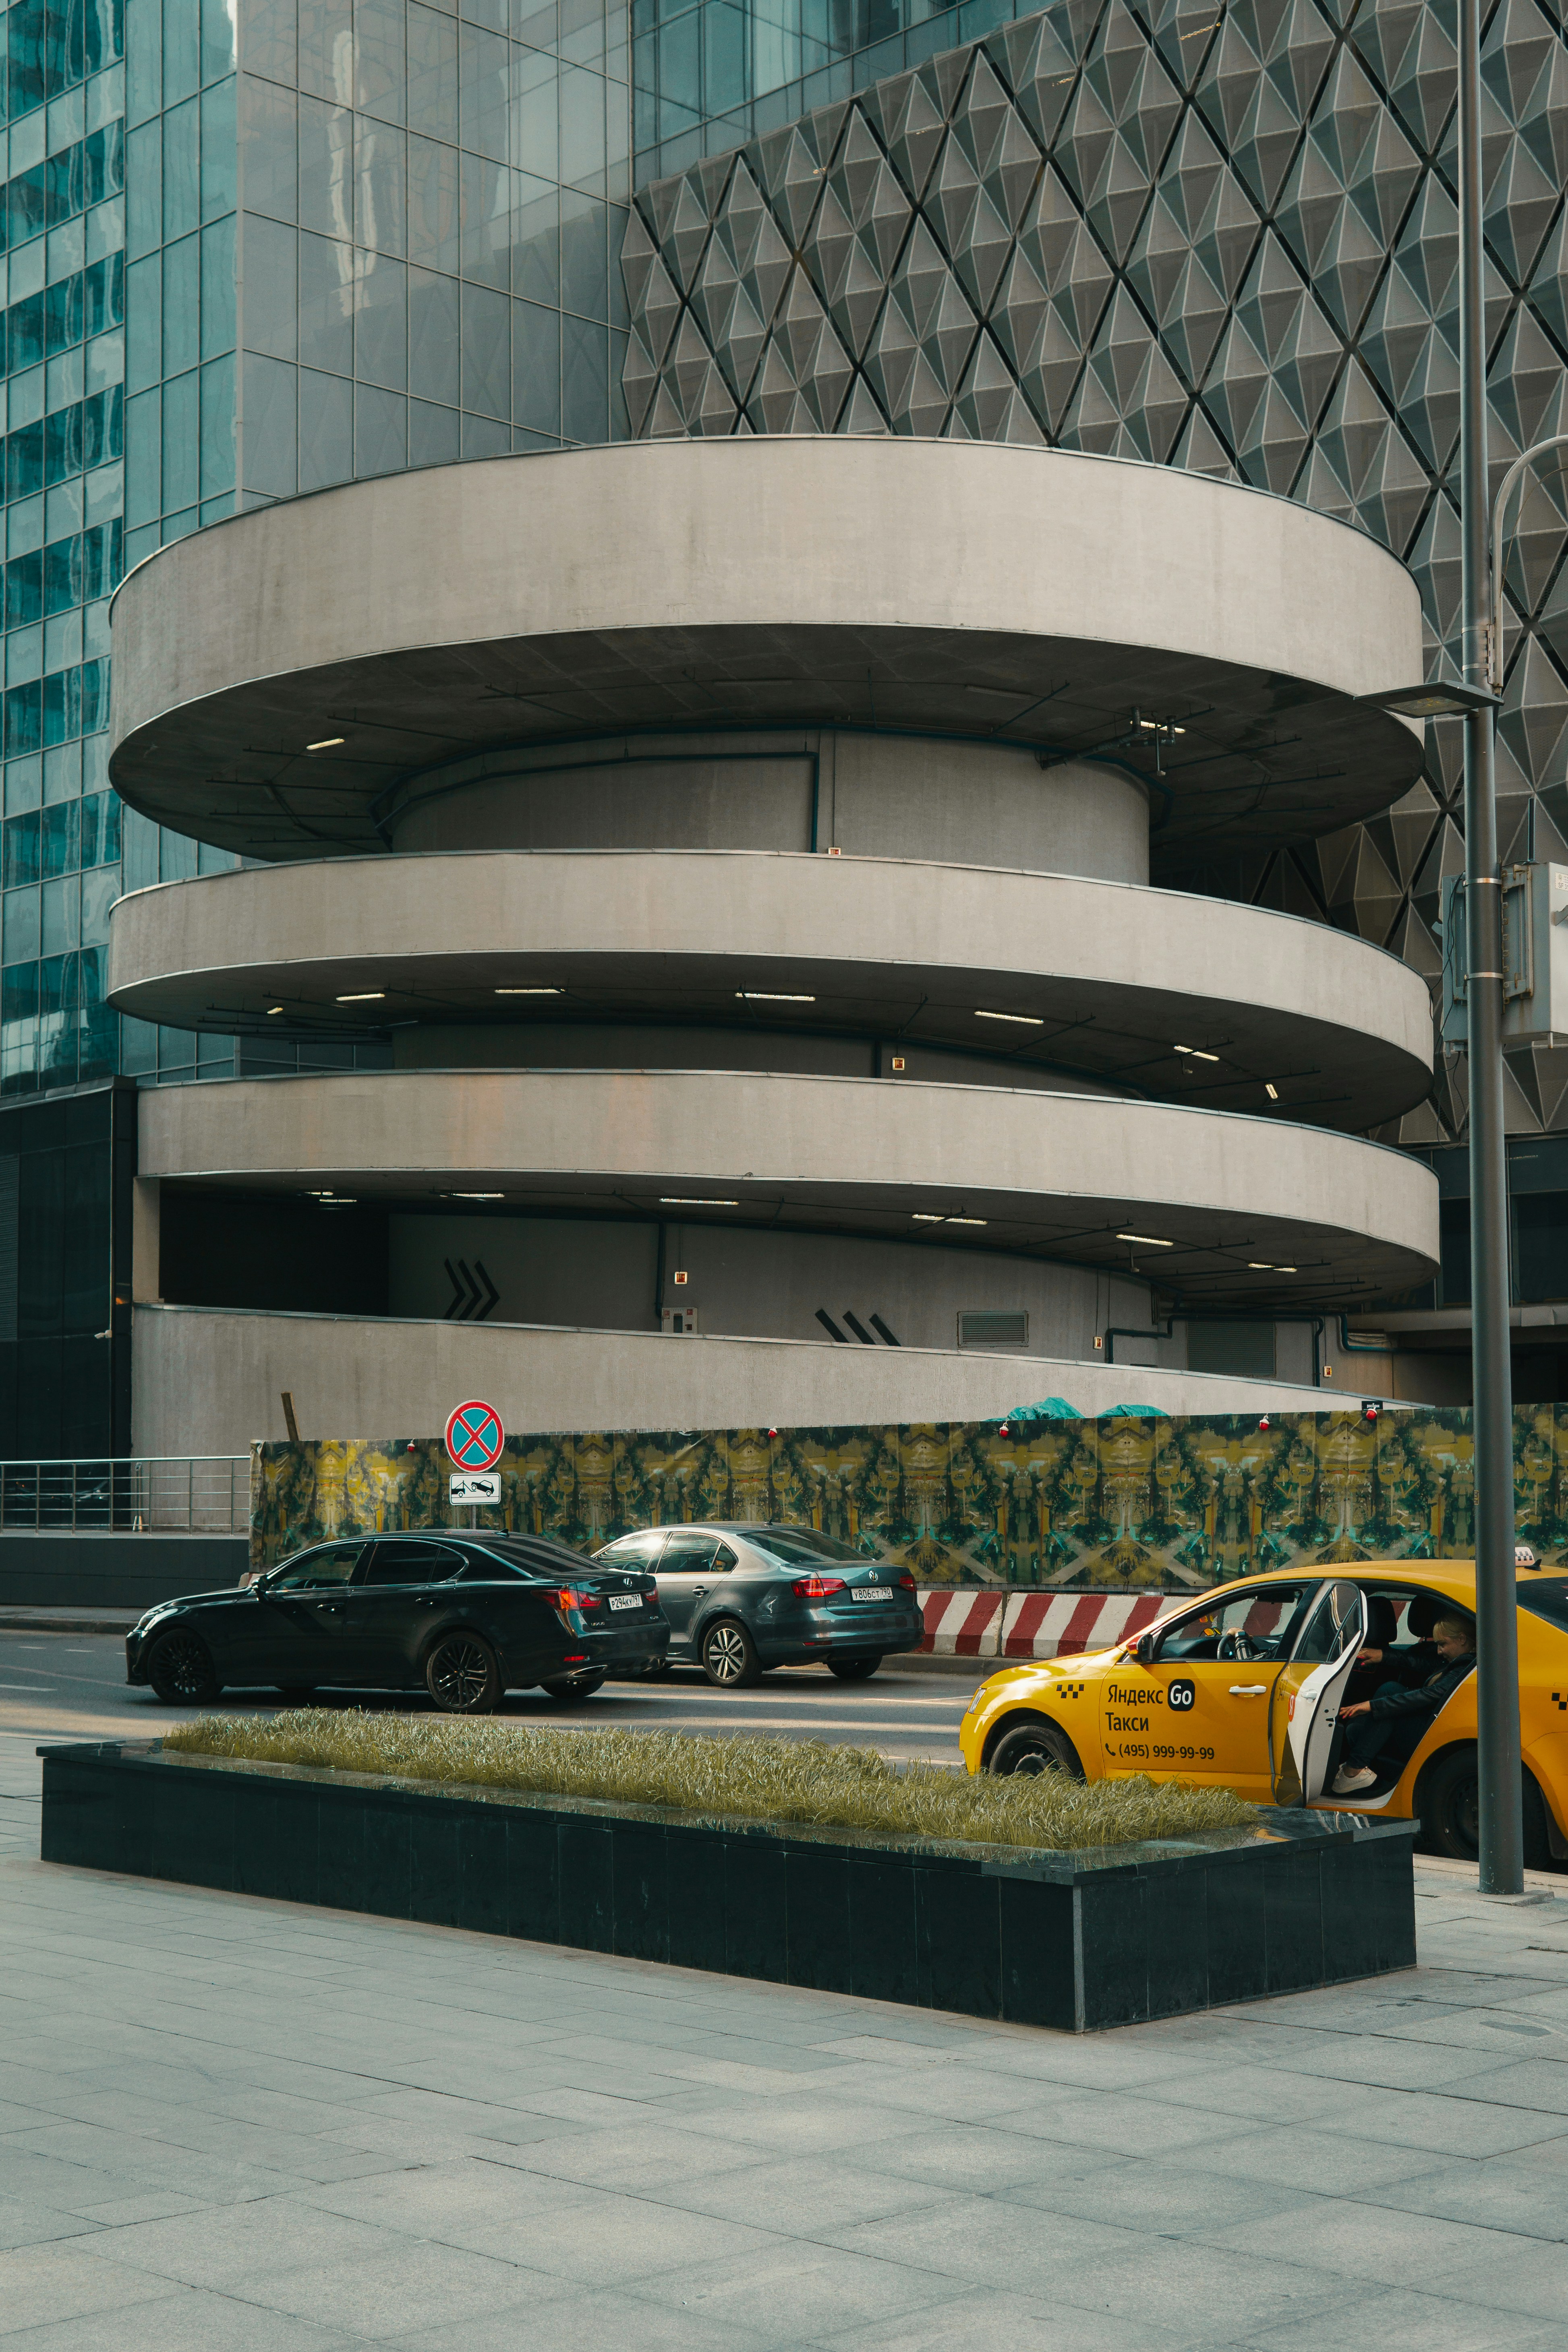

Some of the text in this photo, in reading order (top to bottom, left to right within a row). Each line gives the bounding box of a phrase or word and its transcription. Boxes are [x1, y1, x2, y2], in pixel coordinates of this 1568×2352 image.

[1108, 1685, 1192, 1706] Яндекс Go
[1105, 1712, 1149, 1731] Такси
[1119, 1743, 1214, 1759] (495) 999-99-99
